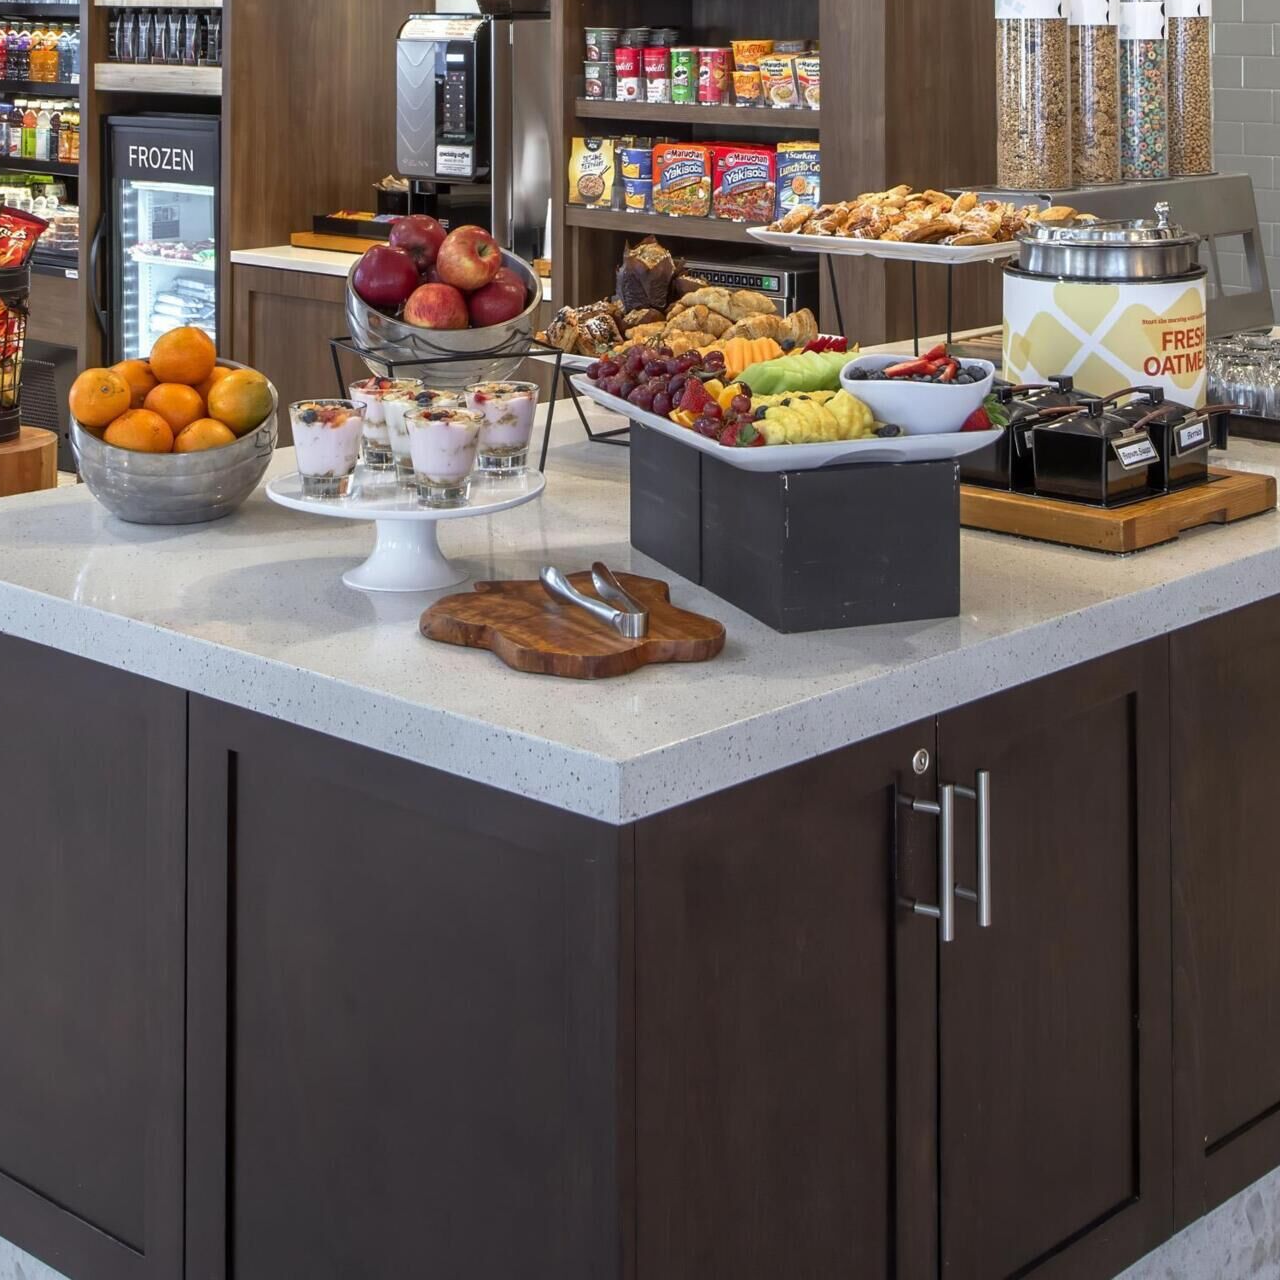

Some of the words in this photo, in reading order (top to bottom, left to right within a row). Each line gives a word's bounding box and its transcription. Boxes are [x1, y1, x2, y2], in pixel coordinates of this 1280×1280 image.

[128, 145, 194, 172] FROZEN
[671, 149, 704, 160] Maruchan
[734, 153, 768, 164] Maruchan
[664, 163, 702, 181] Yakisoba
[726, 167, 767, 184] Yakisoba
